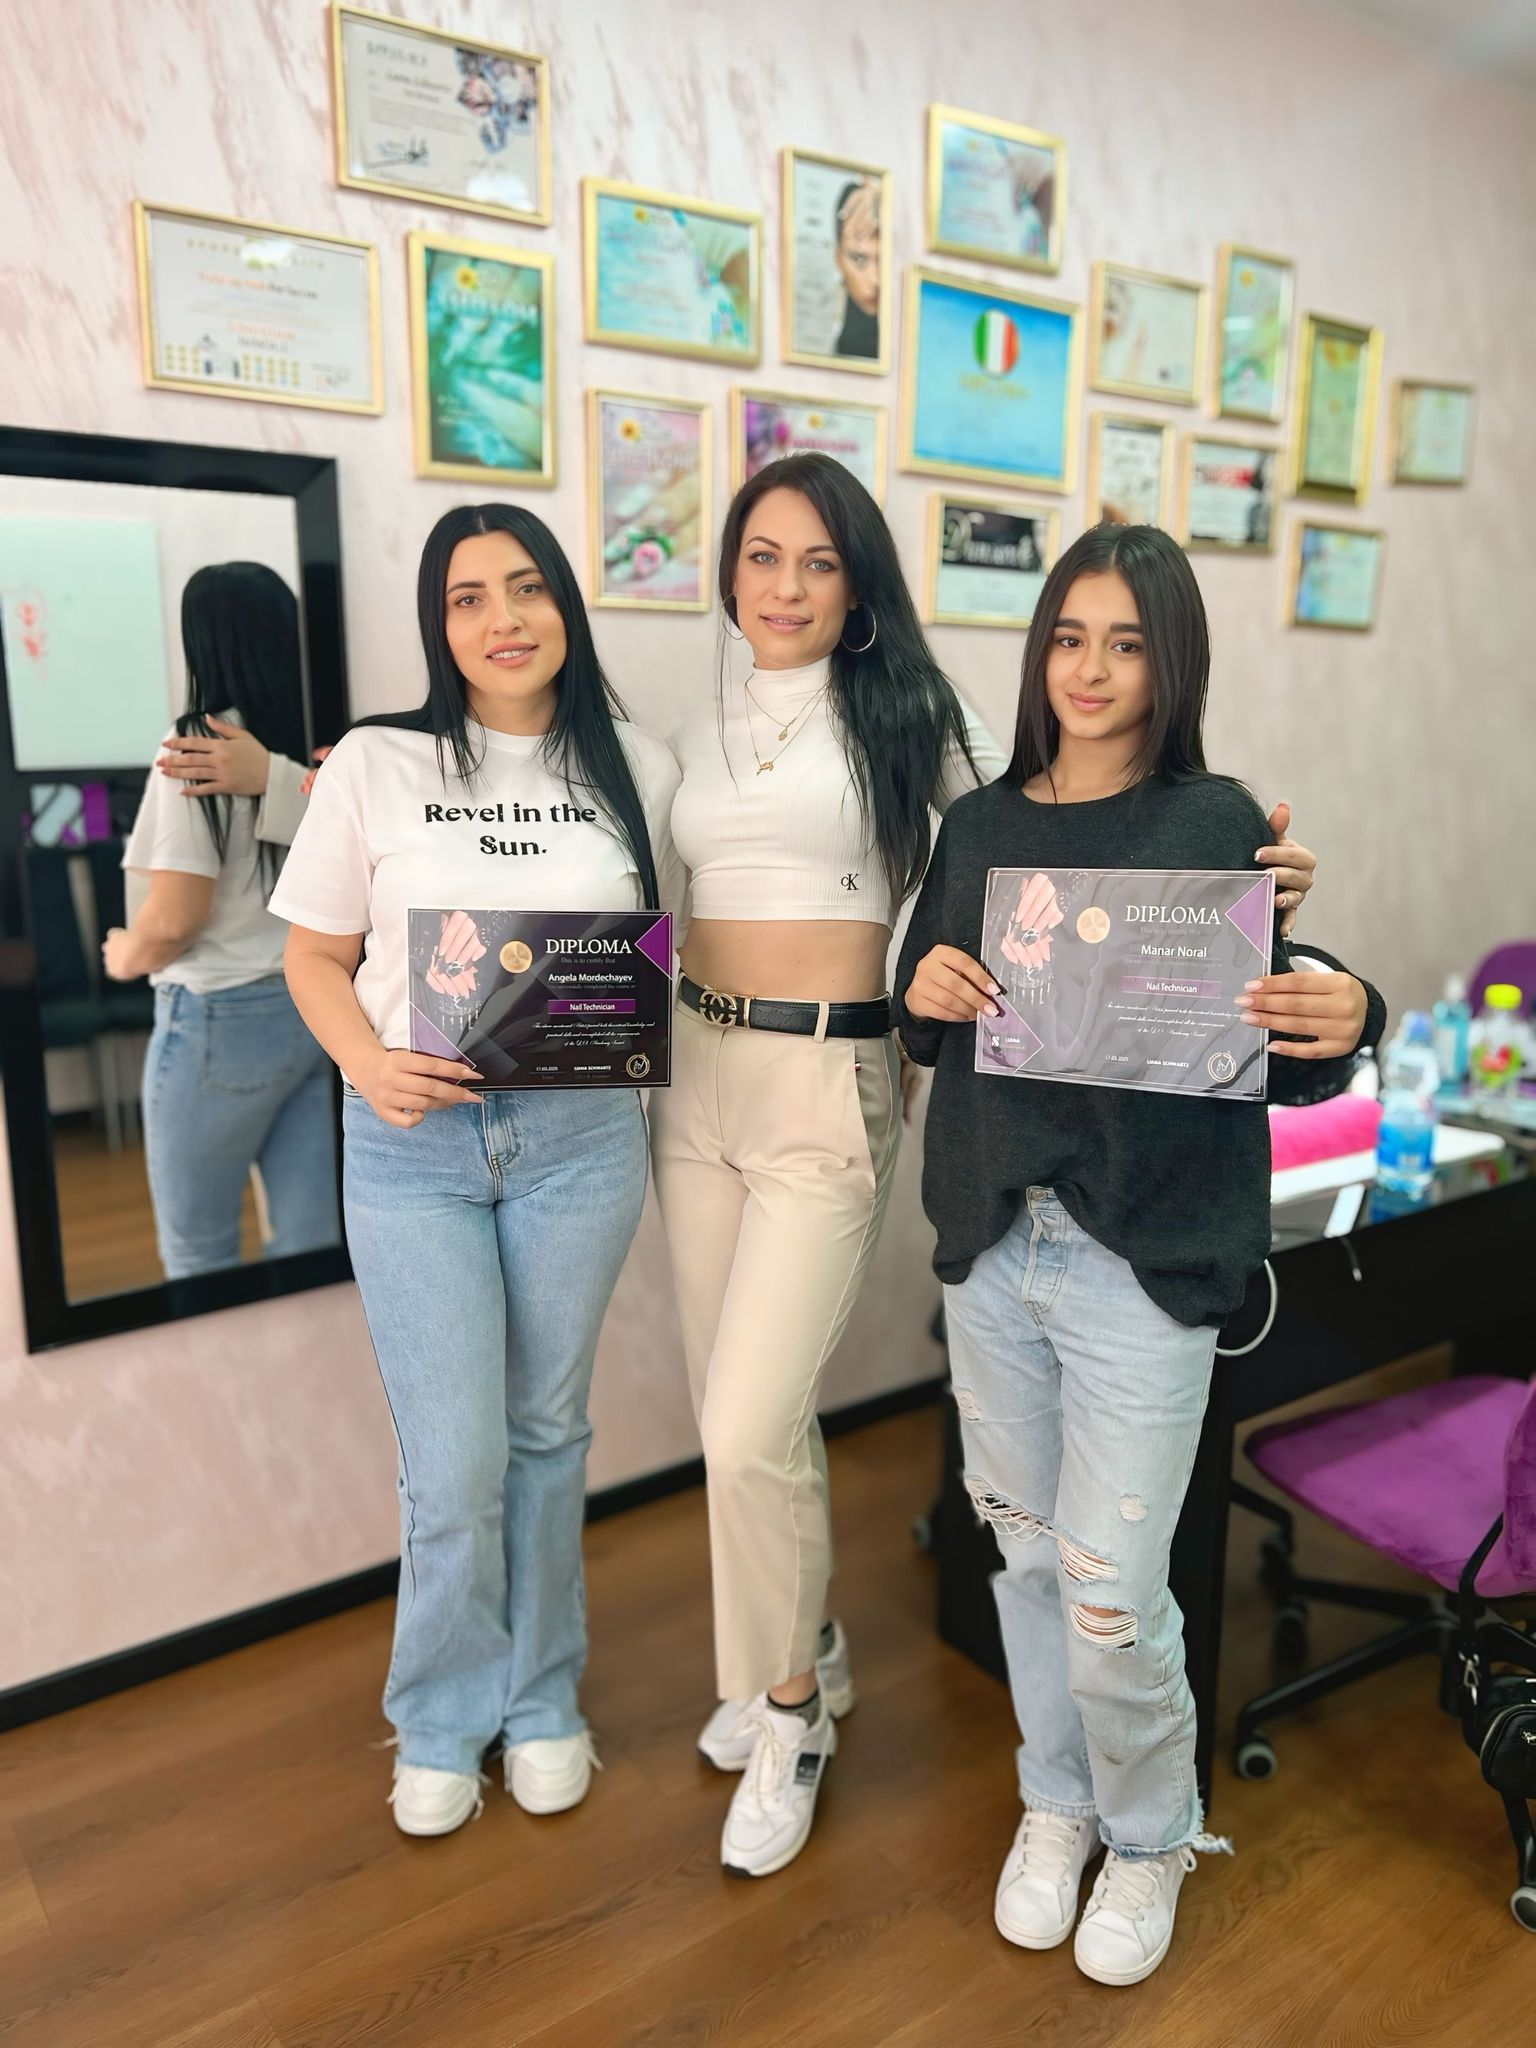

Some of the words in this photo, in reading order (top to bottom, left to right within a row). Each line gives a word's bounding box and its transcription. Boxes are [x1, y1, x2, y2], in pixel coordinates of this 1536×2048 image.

[425, 803, 504, 823] Revel
[513, 802, 541, 823] in
[549, 803, 597, 823] the
[479, 835, 548, 856] Sun.
[1125, 905, 1221, 925] DIPLOMA
[545, 938, 633, 954] DIPLOMA
[1141, 944, 1175, 956] Manar
[1177, 946, 1207, 958] Noral
[548, 973, 577, 983] Angela
[578, 973, 633, 983] Mordechayev
[1146, 982, 1160, 991] Nail
[1161, 982, 1198, 993] Technician
[569, 1003, 582, 1011] Nail
[583, 1003, 616, 1011] Technician
